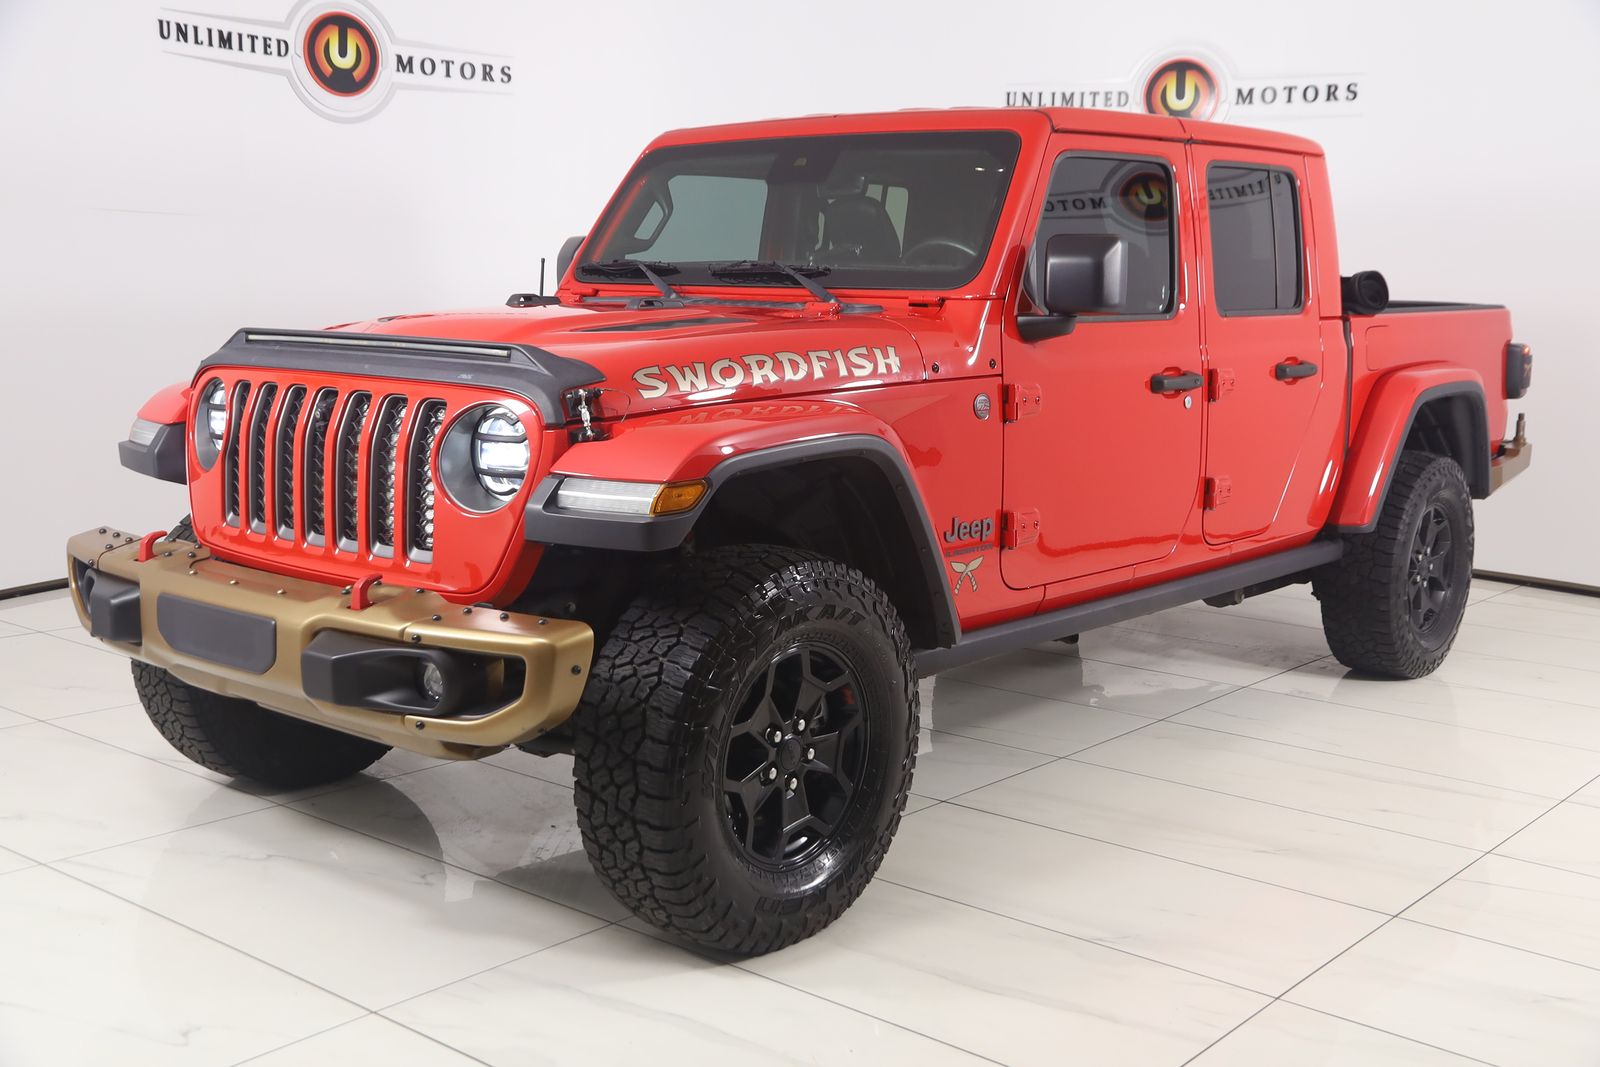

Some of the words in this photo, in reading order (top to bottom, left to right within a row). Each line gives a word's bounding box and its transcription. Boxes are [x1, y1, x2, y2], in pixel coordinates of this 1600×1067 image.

[157, 19, 290, 57] UNLIMITED
[395, 54, 513, 83] MOTORS
[1006, 91, 1130, 108] UNLIMITED
[1235, 83, 1359, 105] MOTORS
[631, 345, 901, 399] SWORDFISH
[944, 517, 993, 543] Jeep
